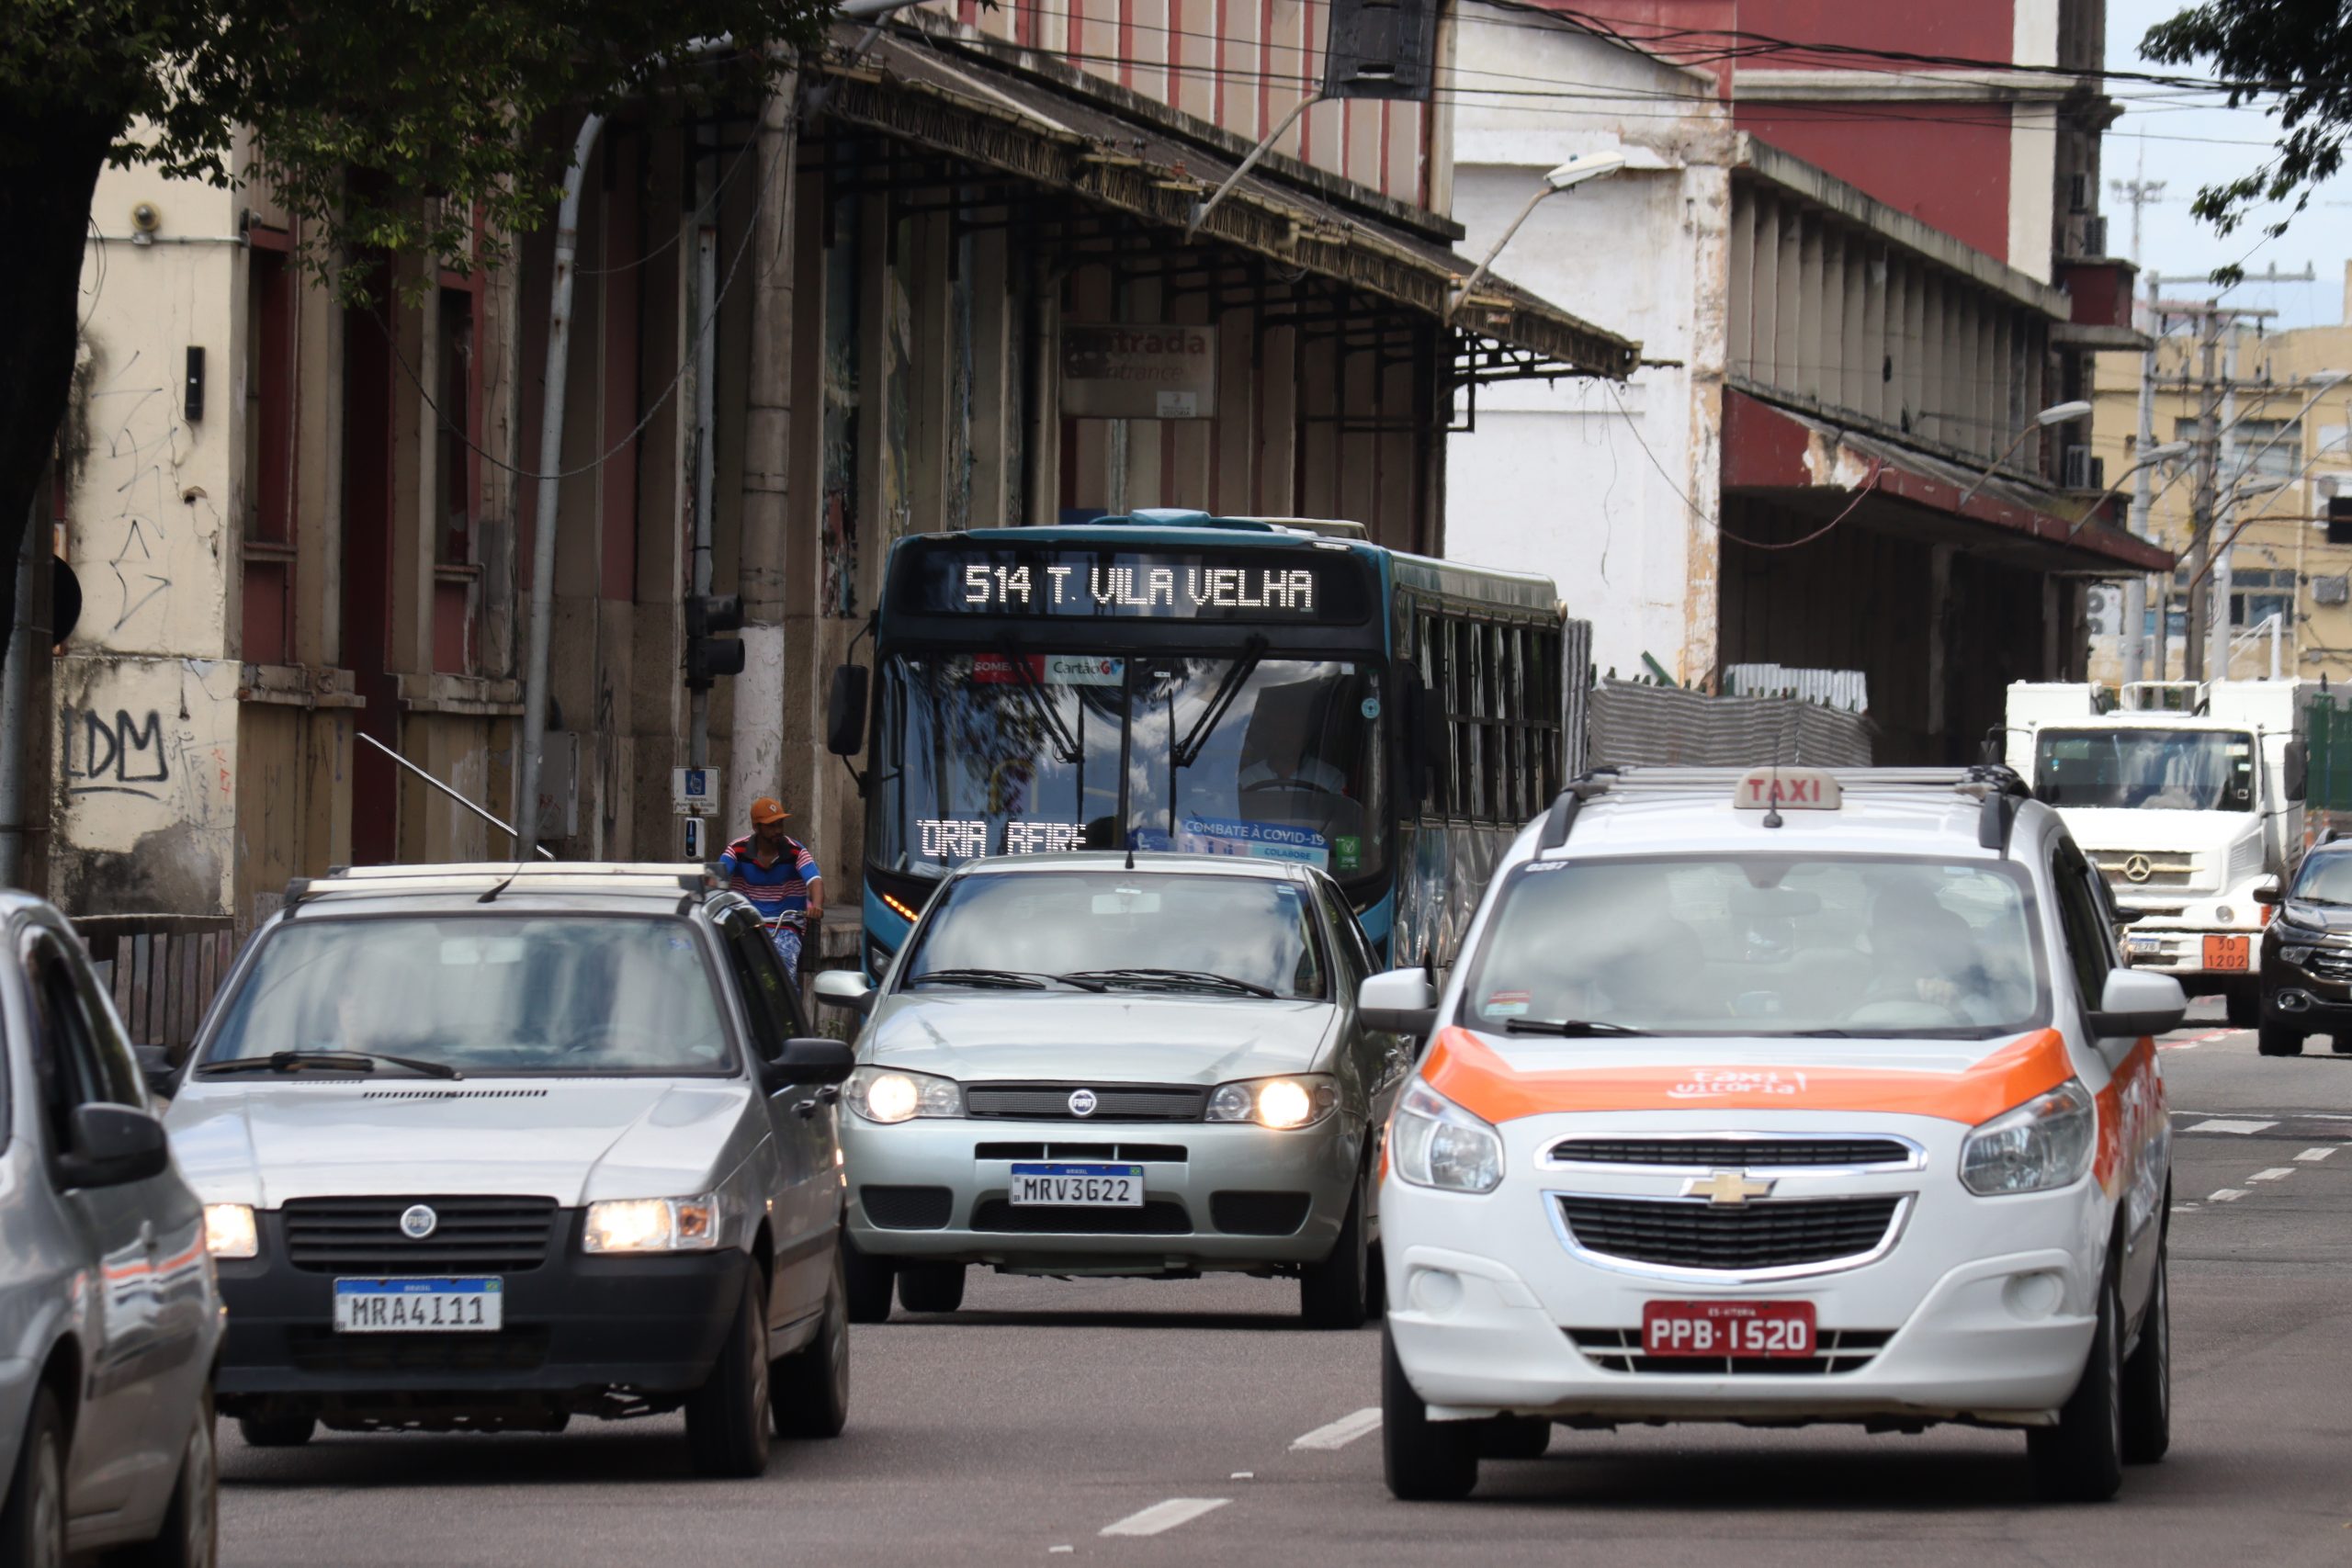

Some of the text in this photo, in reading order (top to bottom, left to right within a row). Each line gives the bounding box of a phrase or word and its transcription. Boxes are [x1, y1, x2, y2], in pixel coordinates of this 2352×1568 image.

[1096, 363, 1184, 381] ntrance
[966, 565, 1312, 607] 514 T. VILA VELHA
[1747, 778, 1820, 802] TAXI
[1184, 819, 1250, 838] COMBATE
[1263, 829, 1326, 846] COVID-19
[1263, 846, 1312, 861] COLABORE
[2209, 956, 2245, 967] 1202
[1023, 1178, 1129, 1202] MRV3G22
